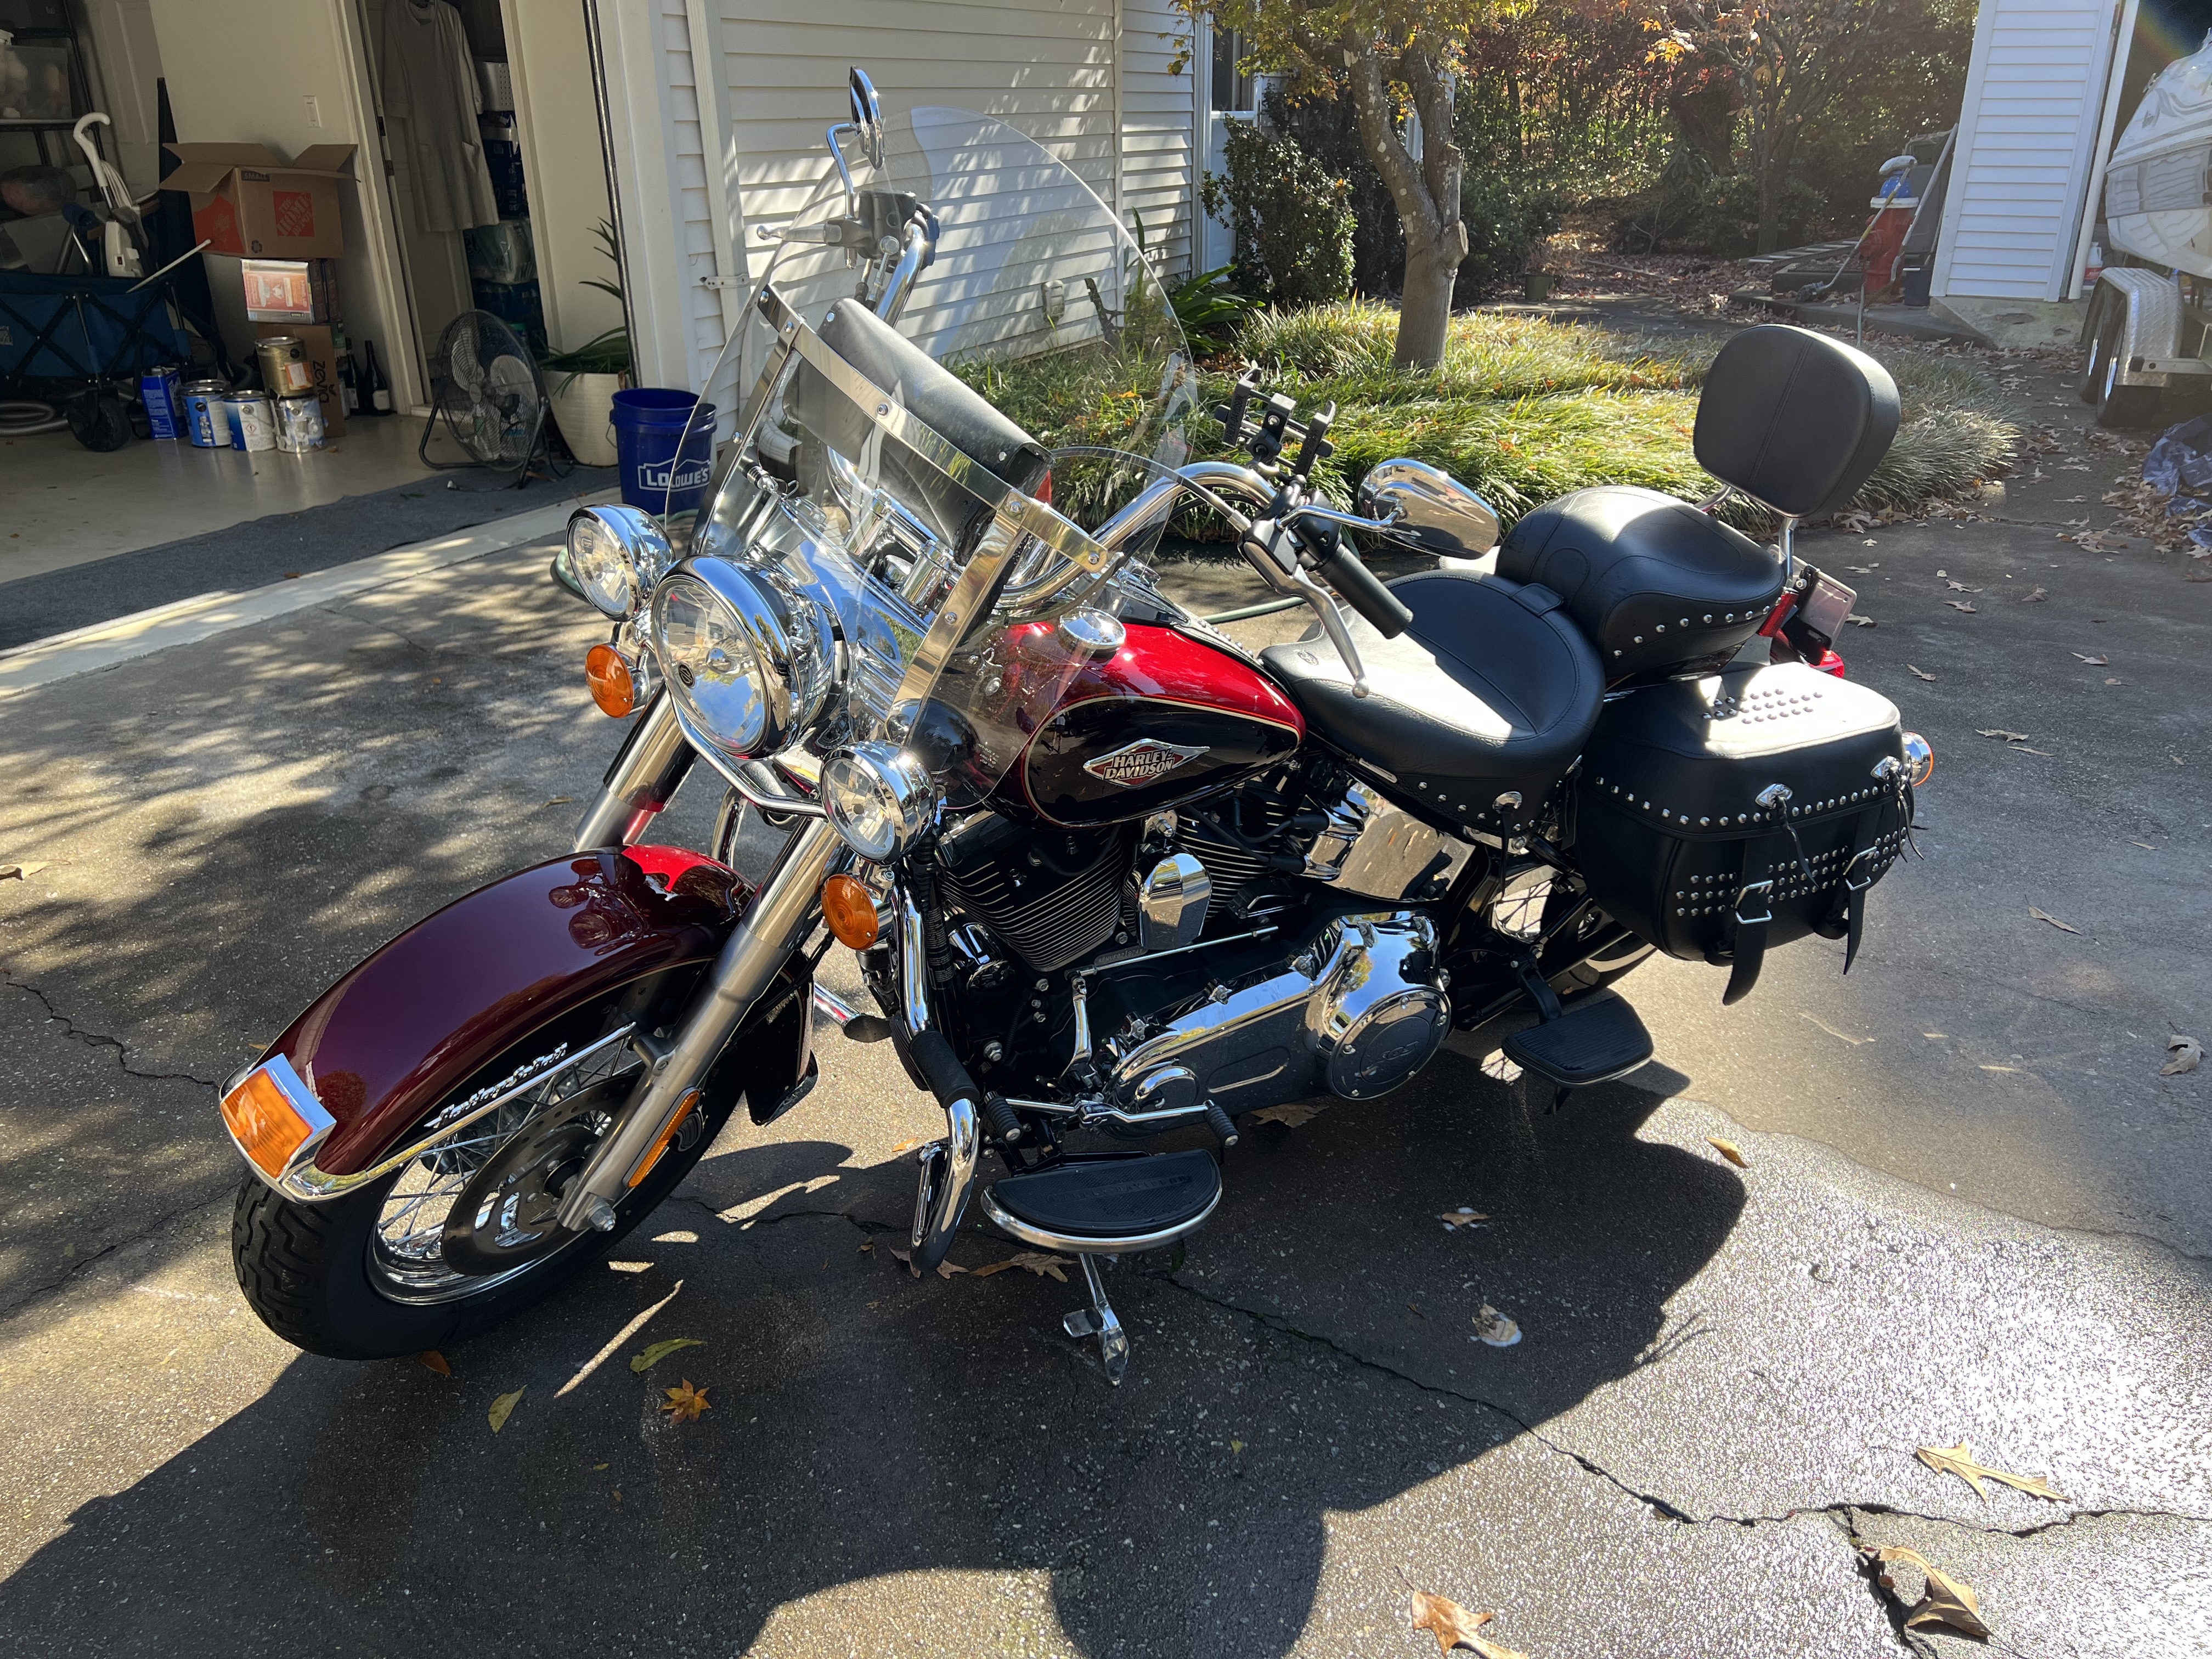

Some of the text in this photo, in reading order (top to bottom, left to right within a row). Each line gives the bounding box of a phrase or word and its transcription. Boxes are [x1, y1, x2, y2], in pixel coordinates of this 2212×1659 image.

[277, 193, 312, 236] HOME
[279, 197, 295, 213] THE
[1105, 761, 1172, 780] DAVIDSON
